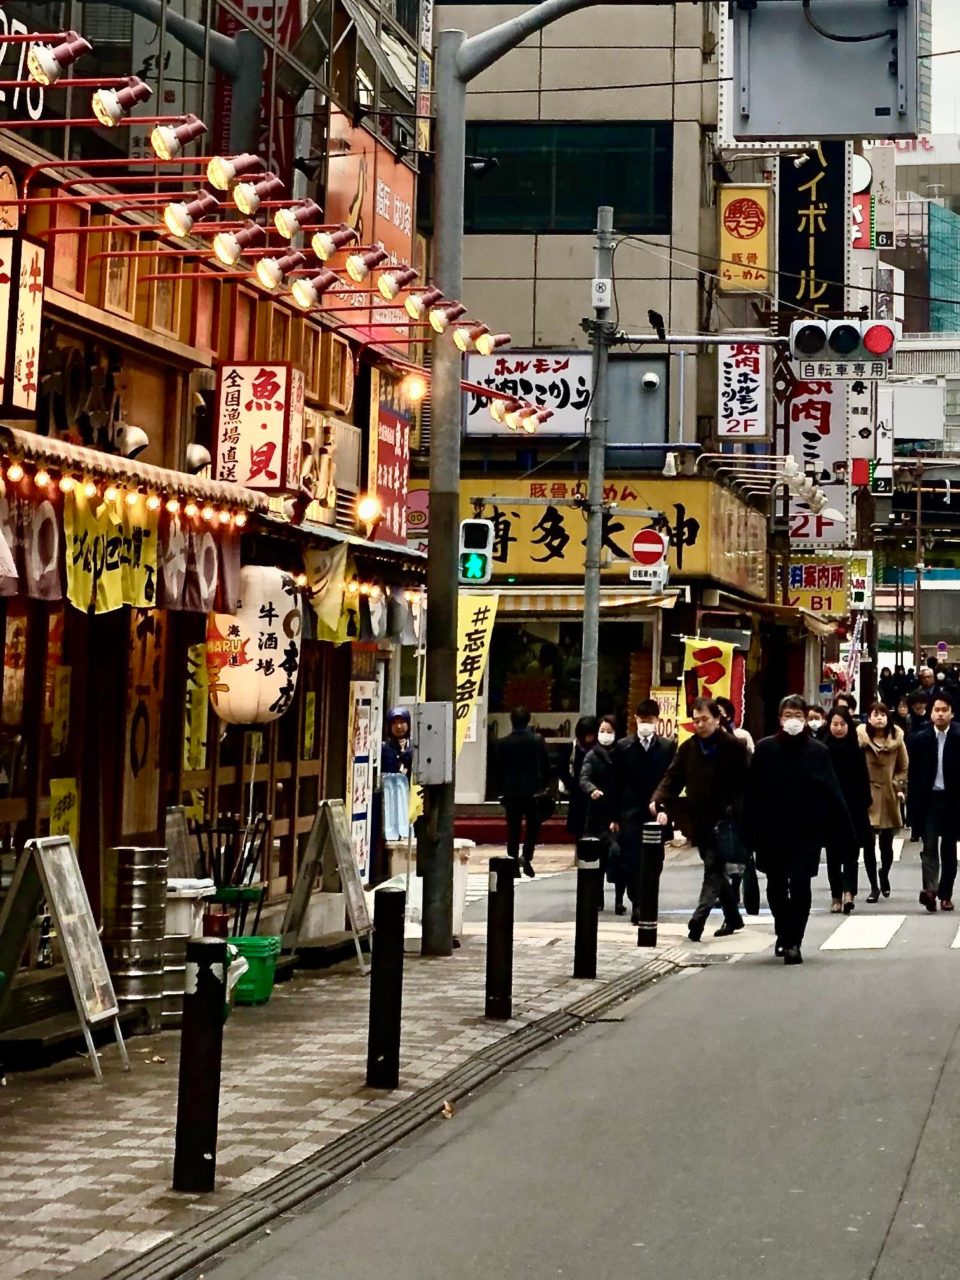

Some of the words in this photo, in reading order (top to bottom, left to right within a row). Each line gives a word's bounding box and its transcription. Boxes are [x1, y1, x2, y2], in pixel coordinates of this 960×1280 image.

[731, 252, 758, 265] 豚骨
[722, 270, 766, 281] らーめん
[494, 357, 570, 376] ホルモン
[804, 363, 884, 377] 自転車専用
[736, 373, 760, 415] ホルモン
[218, 369, 244, 482] 全国漁場直送
[245, 368, 284, 481] 魚・貝
[726, 420, 758, 433] 2F
[530, 482, 638, 502] 豚骨らめん
[779, 564, 844, 589] 料案内所
[811, 596, 832, 610] B1
[255, 601, 280, 676] 牛酒場
